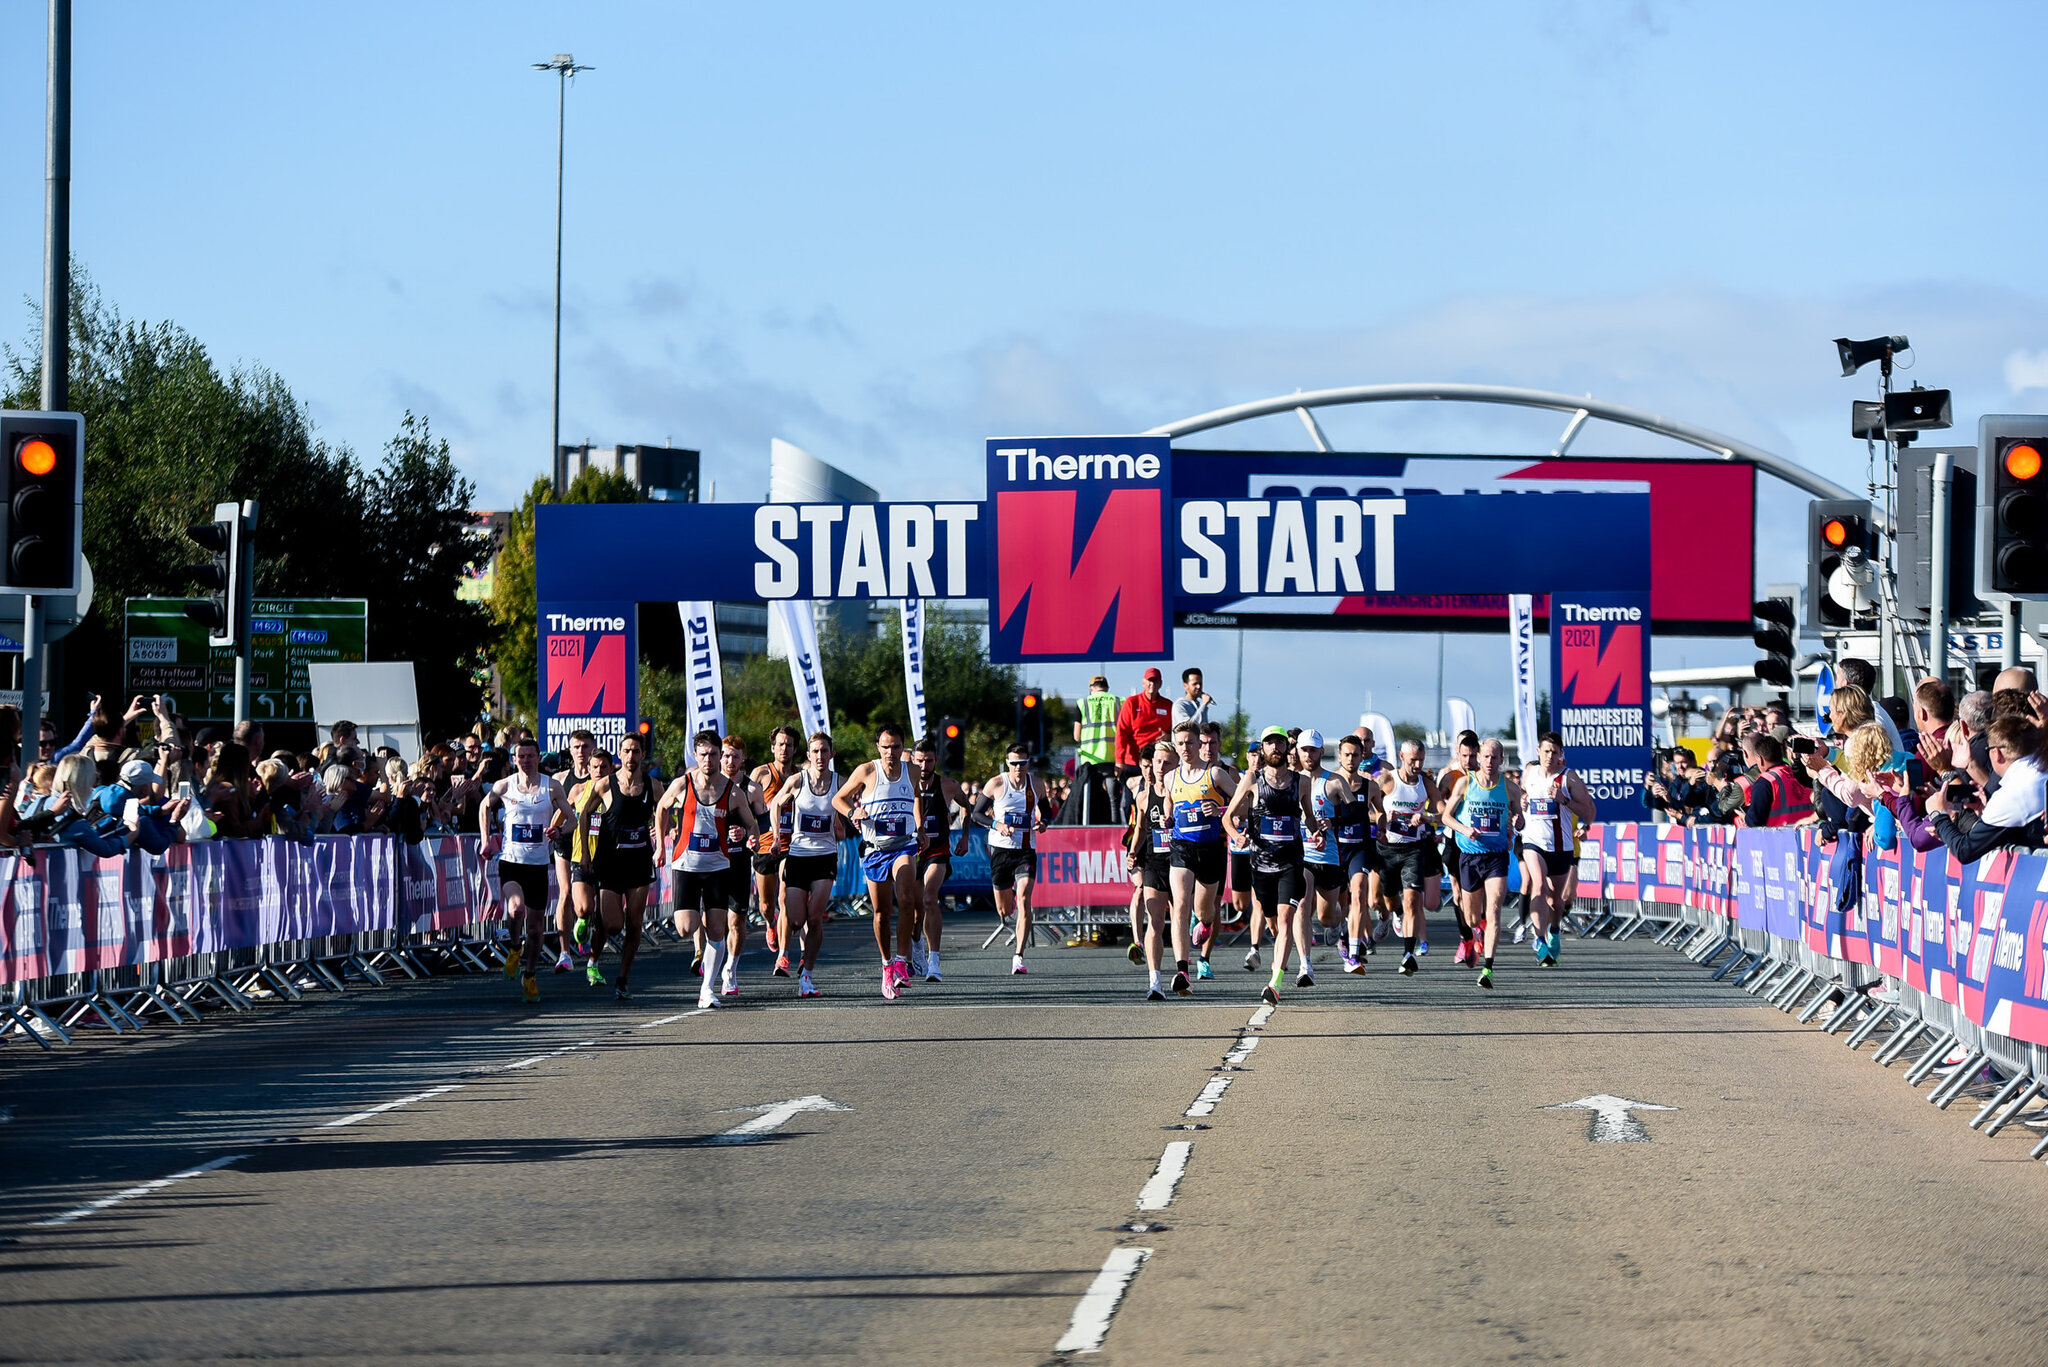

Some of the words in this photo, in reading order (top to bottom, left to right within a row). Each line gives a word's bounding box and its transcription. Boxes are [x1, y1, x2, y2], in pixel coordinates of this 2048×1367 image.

[996, 448, 1161, 482] Therme
[754, 504, 978, 598] START
[1181, 499, 1407, 594] START
[258, 603, 294, 613] CIRCLE
[1560, 603, 1642, 621] Therme
[546, 614, 625, 632] Therme
[1184, 613, 1238, 625] JCDecaux
[133, 640, 174, 649] Chorlton
[1565, 630, 1596, 647] 2021
[214, 649, 238, 658] Traff
[254, 649, 274, 658] Park
[290, 648, 340, 657] Altrincham
[550, 639, 580, 656] 2021
[140, 668, 156, 677] Old
[160, 668, 196, 677] Trafford
[292, 669, 309, 678] Whi
[132, 678, 166, 687] Cricket
[169, 678, 203, 687] Ground
[216, 674, 234, 683] The
[250, 676, 265, 685] ays
[290, 679, 311, 689] Reta
[1561, 708, 1643, 726] MANCHESTER
[547, 717, 627, 735] MANCHESTER
[1563, 726, 1644, 747] MARATHON
[1576, 769, 1644, 785] HERME
[1587, 786, 1635, 800] ROUP
[811, 820, 821, 829] 43
[1187, 813, 1198, 823] 59
[1273, 821, 1283, 831] 52
[522, 829, 533, 839] 94
[403, 876, 436, 901] Therme
[1993, 918, 2025, 972] Therme
